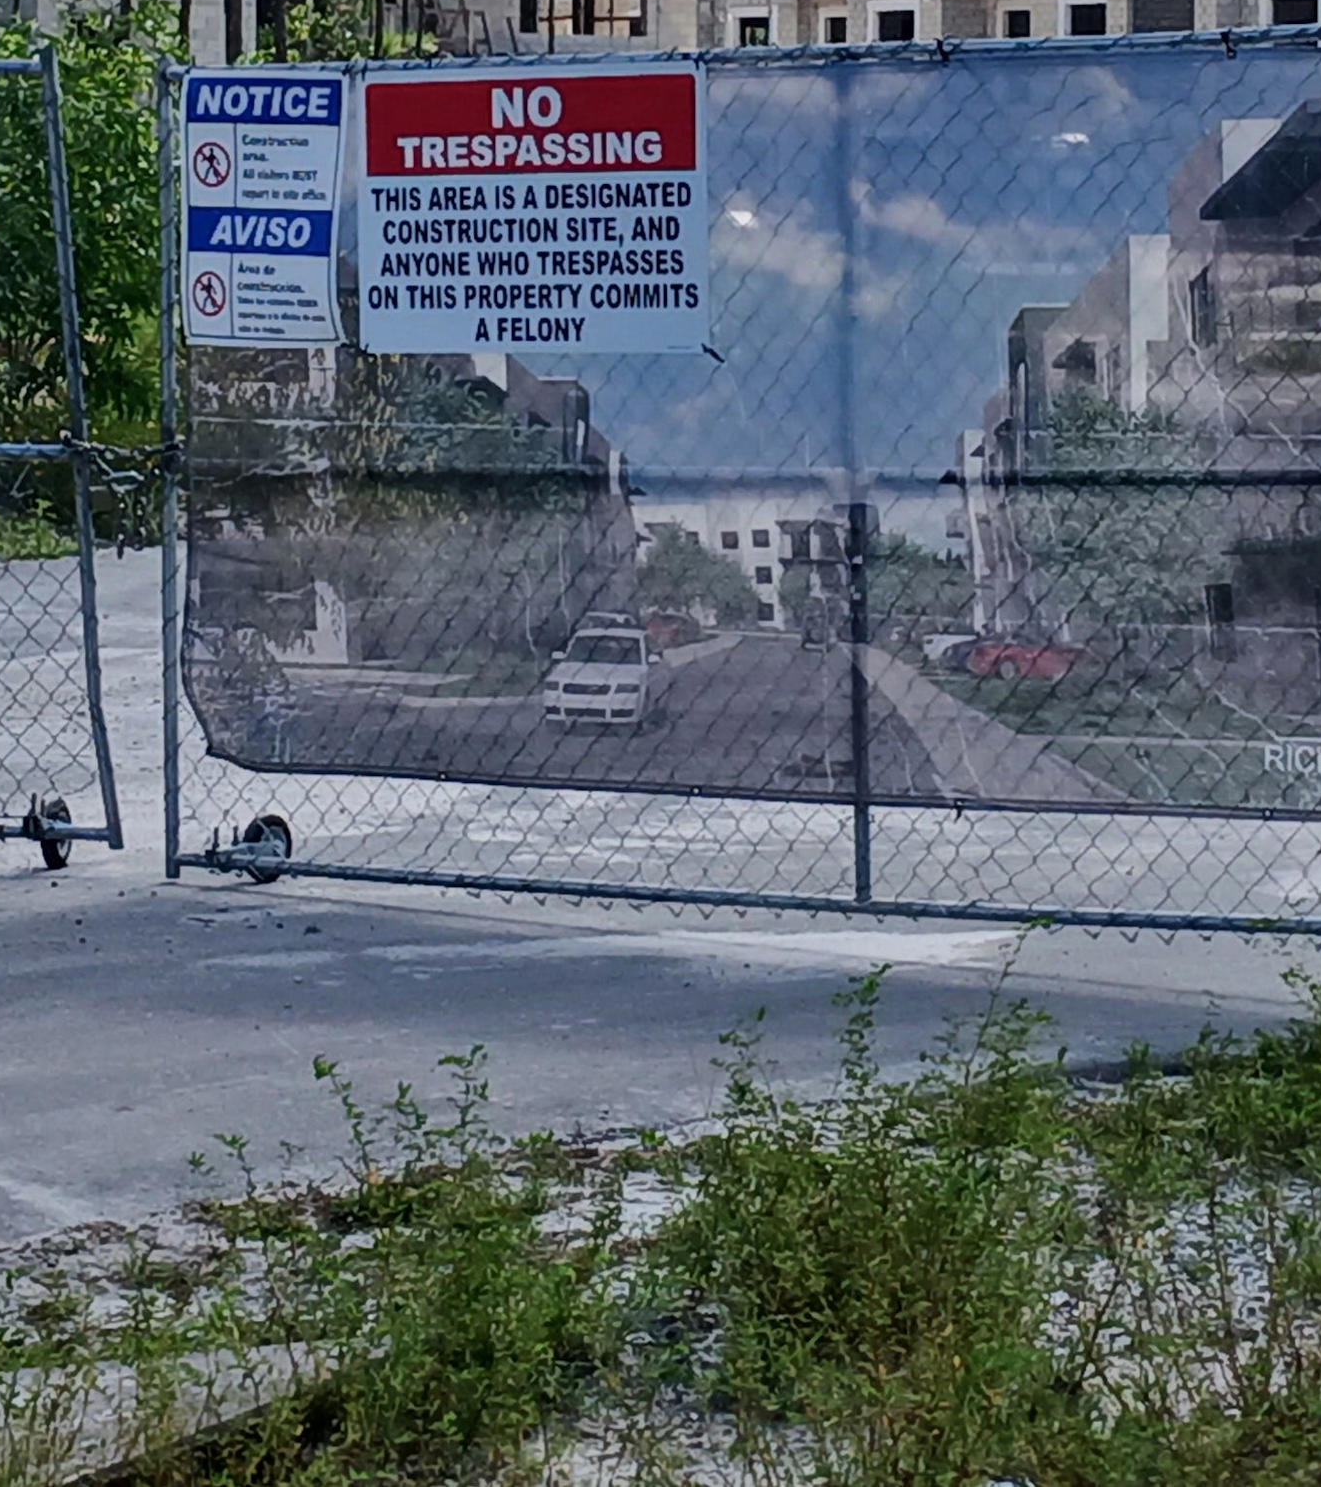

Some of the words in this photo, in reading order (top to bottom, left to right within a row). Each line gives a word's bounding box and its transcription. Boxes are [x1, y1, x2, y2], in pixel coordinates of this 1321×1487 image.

[196, 84, 332, 118] NOTICE
[490, 85, 563, 129] NO
[396, 130, 663, 169] TRESPASSING
[371, 187, 421, 212] THIS
[428, 186, 487, 211] AREA
[494, 185, 516, 210] IS
[522, 185, 538, 210] A
[545, 181, 692, 209] DESIGNATED
[209, 214, 312, 249] AVISO
[382, 217, 558, 245] CONSTRUCTION
[566, 216, 624, 248] SITE,
[631, 215, 680, 242] AND
[380, 251, 471, 277] ANYONE
[477, 250, 530, 277] WHO
[536, 249, 685, 276] TRESPASSES
[368, 284, 399, 310] ON
[406, 284, 457, 310] THIS
[463, 283, 583, 310] PROPERTY
[589, 282, 700, 310] COMMITS
[474, 317, 490, 343] A
[496, 317, 587, 343] FELONY
